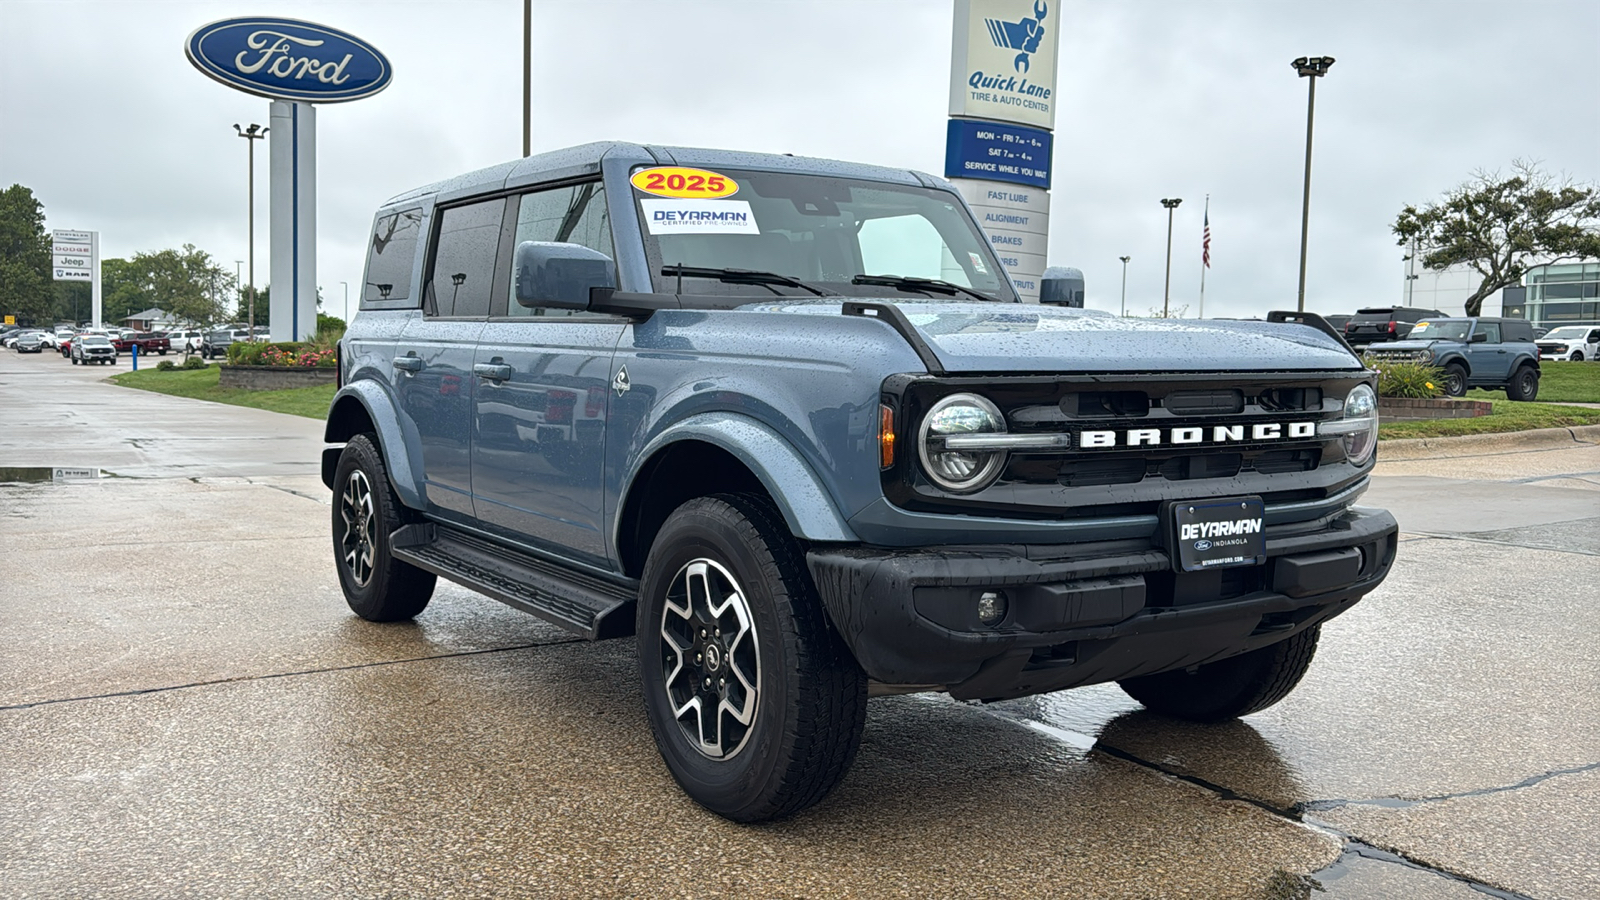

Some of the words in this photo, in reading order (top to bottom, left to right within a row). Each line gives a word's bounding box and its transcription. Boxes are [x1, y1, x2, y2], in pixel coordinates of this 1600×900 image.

[235, 30, 353, 85] Ford
[968, 71, 1017, 92] Quick
[1017, 79, 1051, 99] Lane
[971, 91, 991, 102] TIRE
[992, 94, 998, 103] &
[1000, 95, 1022, 107] AUTO
[1023, 99, 1049, 113] CENTER
[976, 131, 994, 141] MON
[1002, 134, 1014, 142] FRI
[988, 147, 1002, 157] SAT
[964, 161, 997, 172] SERVICE
[998, 164, 1019, 174] WHILE
[1020, 167, 1033, 176] YOU
[1034, 170, 1047, 179] WAIT
[645, 173, 726, 193] 2025
[988, 190, 1008, 201] FAST
[1009, 193, 1029, 203] LUBE
[653, 210, 747, 222] DEYARMAN
[985, 213, 1029, 225] ALIGNMENT
[991, 235, 1023, 246] BRAKES
[61, 257, 84, 266] Jeep
[1001, 257, 1019, 267] RES
[1012, 279, 1035, 290] TRUTS
[1079, 421, 1316, 448] BRONCO
[1181, 518, 1262, 540] DEYARMAN
[1213, 538, 1248, 547] INDIANOLA
